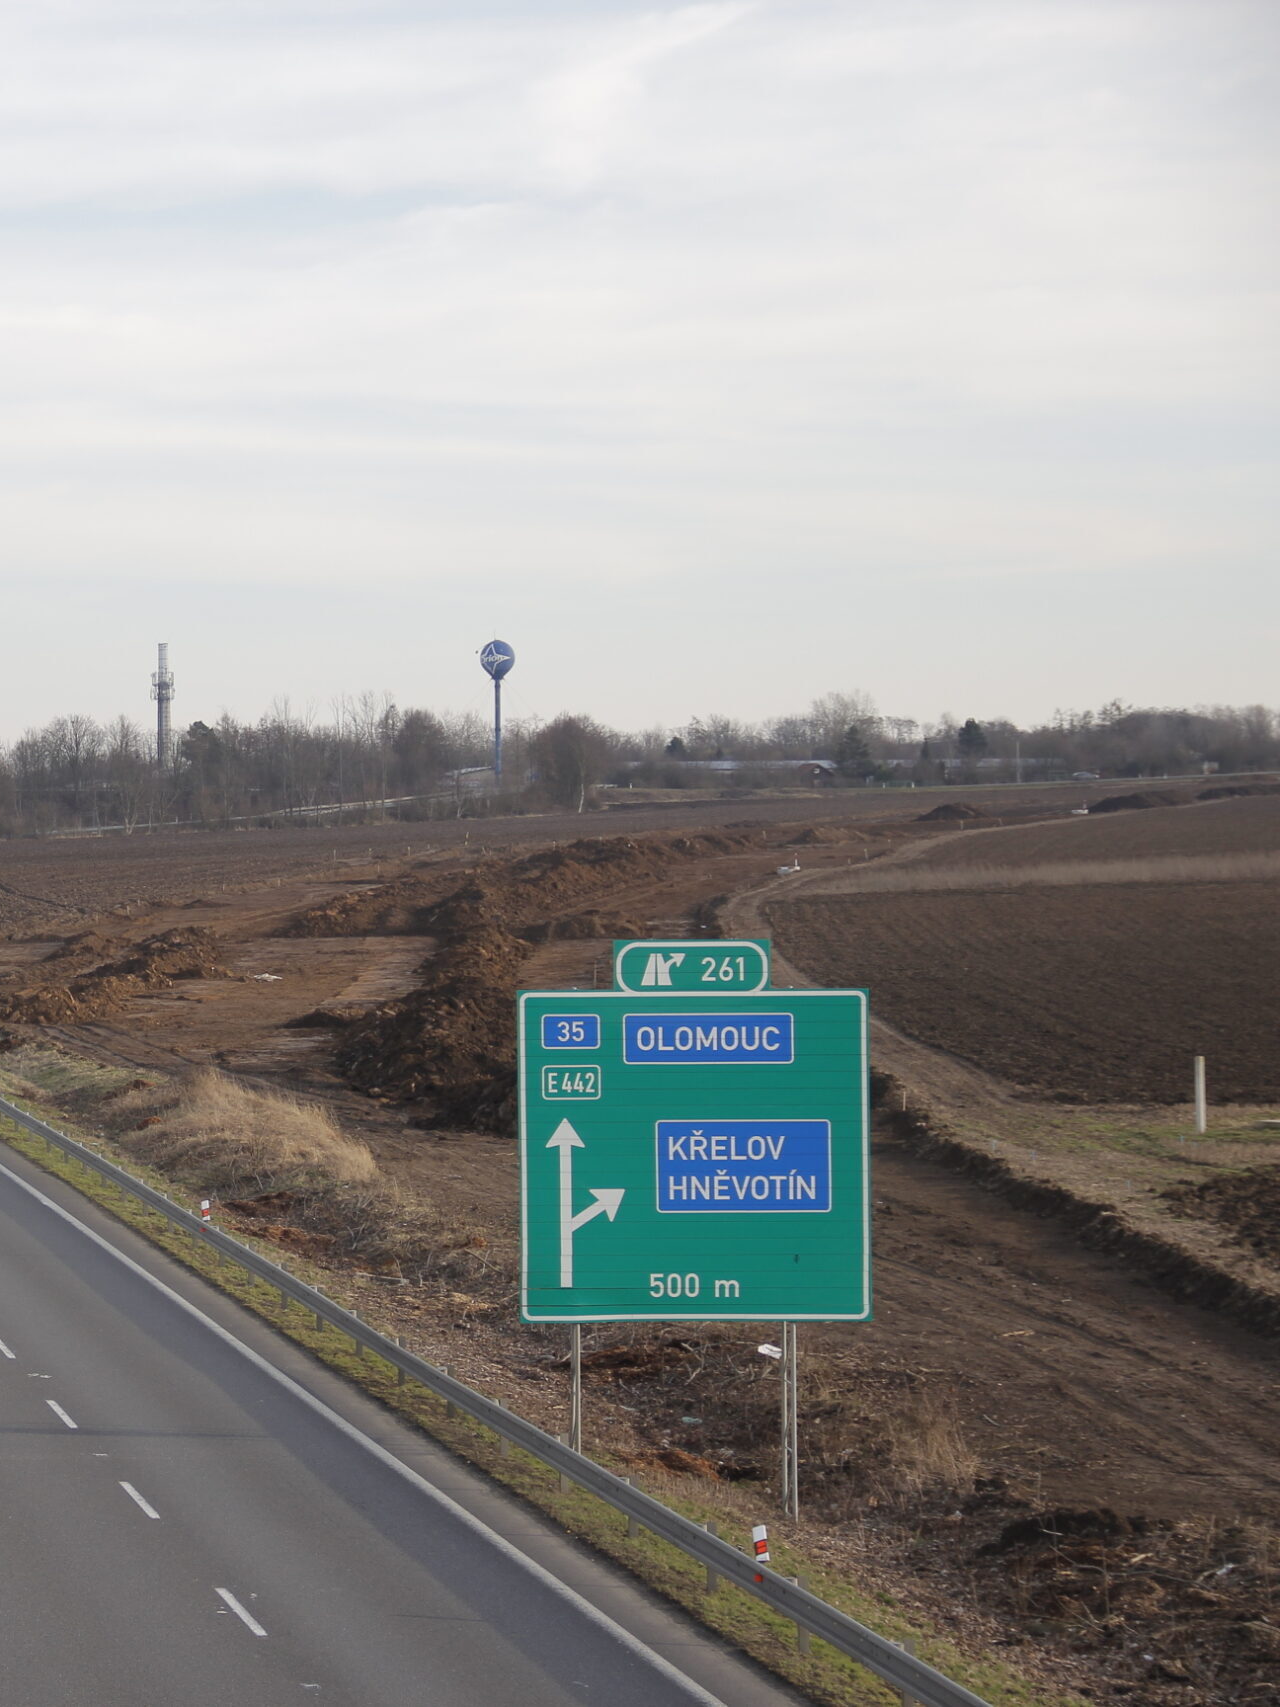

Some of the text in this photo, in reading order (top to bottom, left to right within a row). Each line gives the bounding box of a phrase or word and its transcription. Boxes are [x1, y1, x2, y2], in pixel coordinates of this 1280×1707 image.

[701, 956, 745, 982] 261
[557, 1021, 585, 1042] 35
[636, 1026, 780, 1051] OLOMOUC
[668, 1129, 785, 1161] KŘELOV
[669, 1169, 816, 1200] HNĚVOTÍN
[650, 1273, 740, 1298] 500 m
